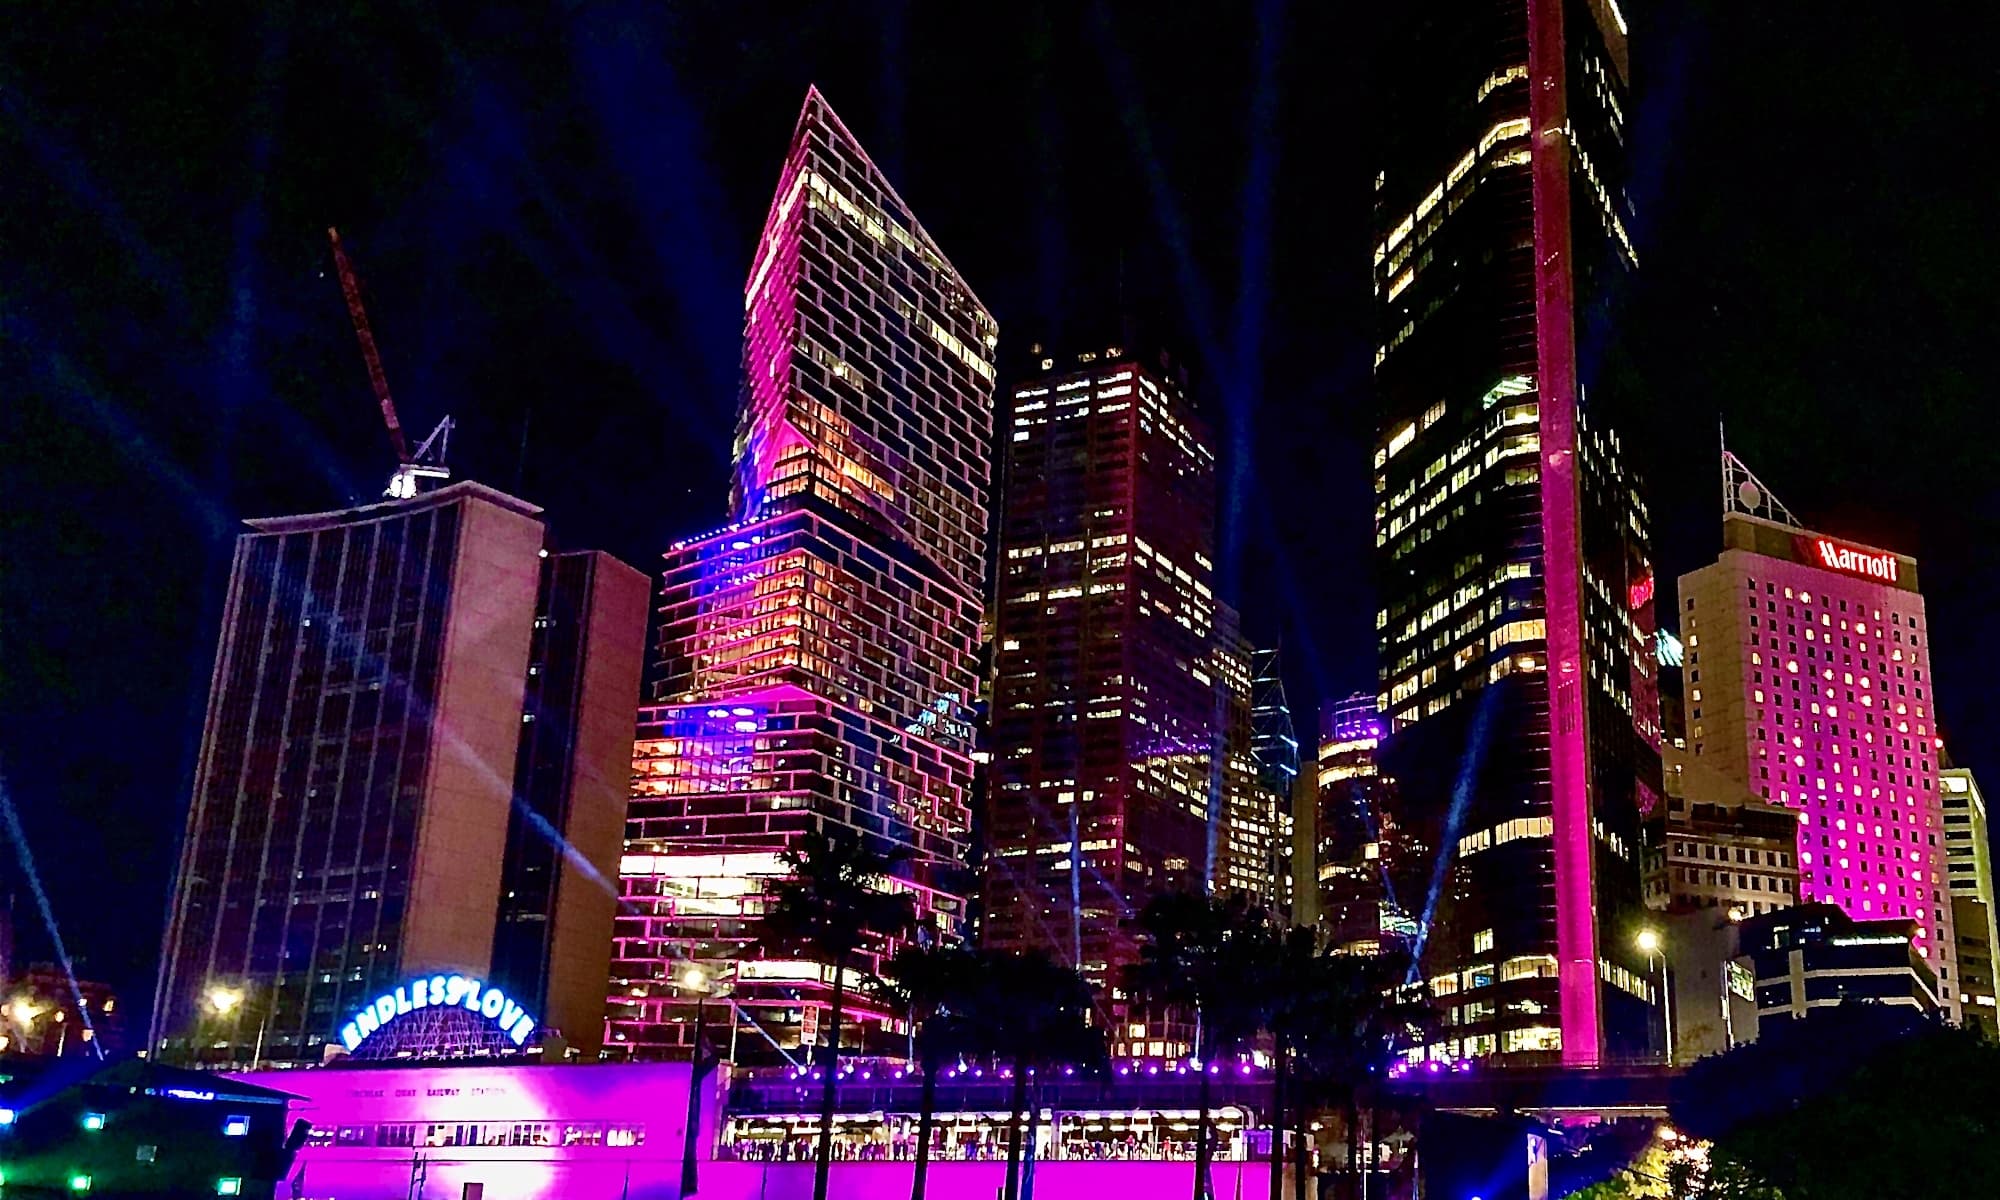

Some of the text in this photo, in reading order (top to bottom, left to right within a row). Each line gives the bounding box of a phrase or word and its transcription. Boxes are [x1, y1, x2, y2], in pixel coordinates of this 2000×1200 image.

[1818, 541, 1897, 581] Marriott
[342, 975, 535, 1051] ENDLESS LOVE
